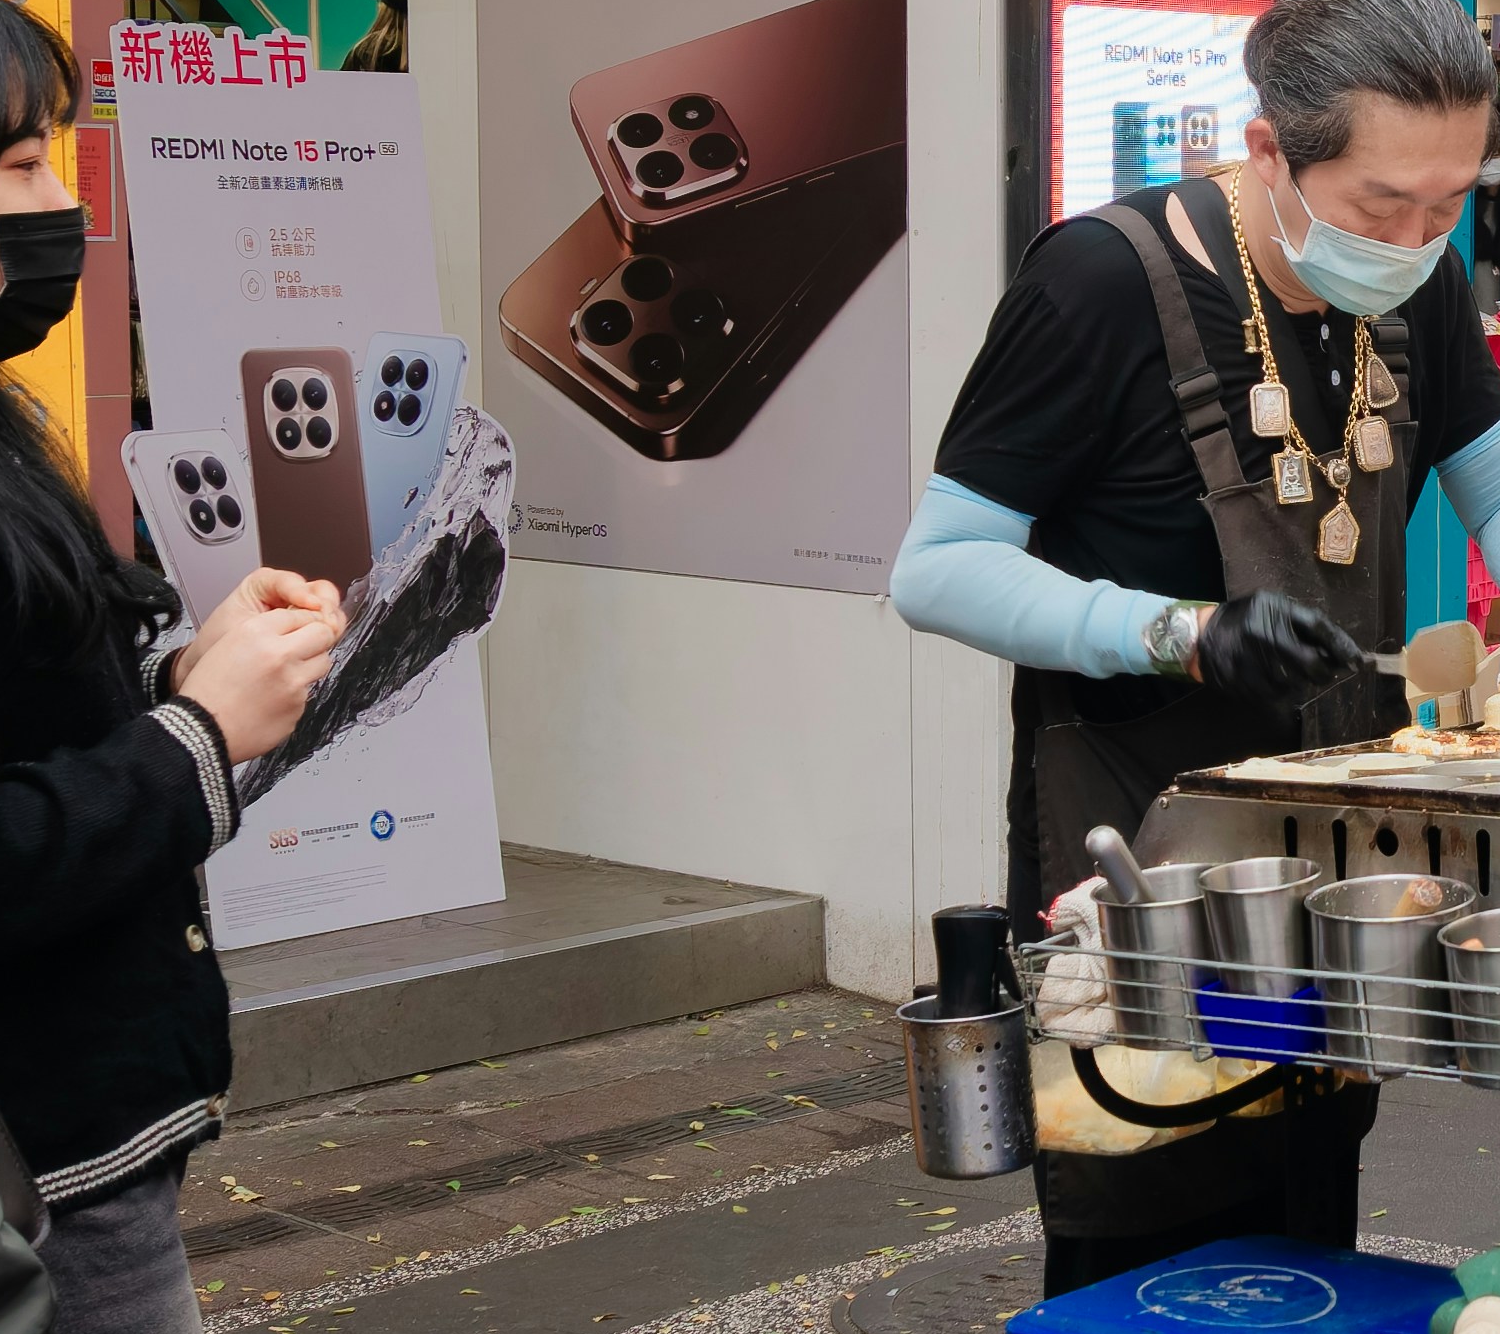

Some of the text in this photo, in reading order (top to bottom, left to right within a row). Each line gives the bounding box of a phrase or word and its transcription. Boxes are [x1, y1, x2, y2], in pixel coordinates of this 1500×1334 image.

[119, 27, 308, 89] 新機上市
[1104, 43, 1228, 68] REDMI Note 15 Pro
[1146, 67, 1187, 88] Series
[150, 137, 225, 161] REDMI
[232, 139, 288, 162] Note
[294, 140, 318, 162] 15
[325, 141, 377, 163] Pro+
[269, 227, 316, 243] 2.5 公尺
[274, 271, 302, 284] IP68
[527, 504, 556, 516] Powered
[528, 518, 608, 539] Xiaomi HyperOS
[268, 827, 299, 849] SGS
